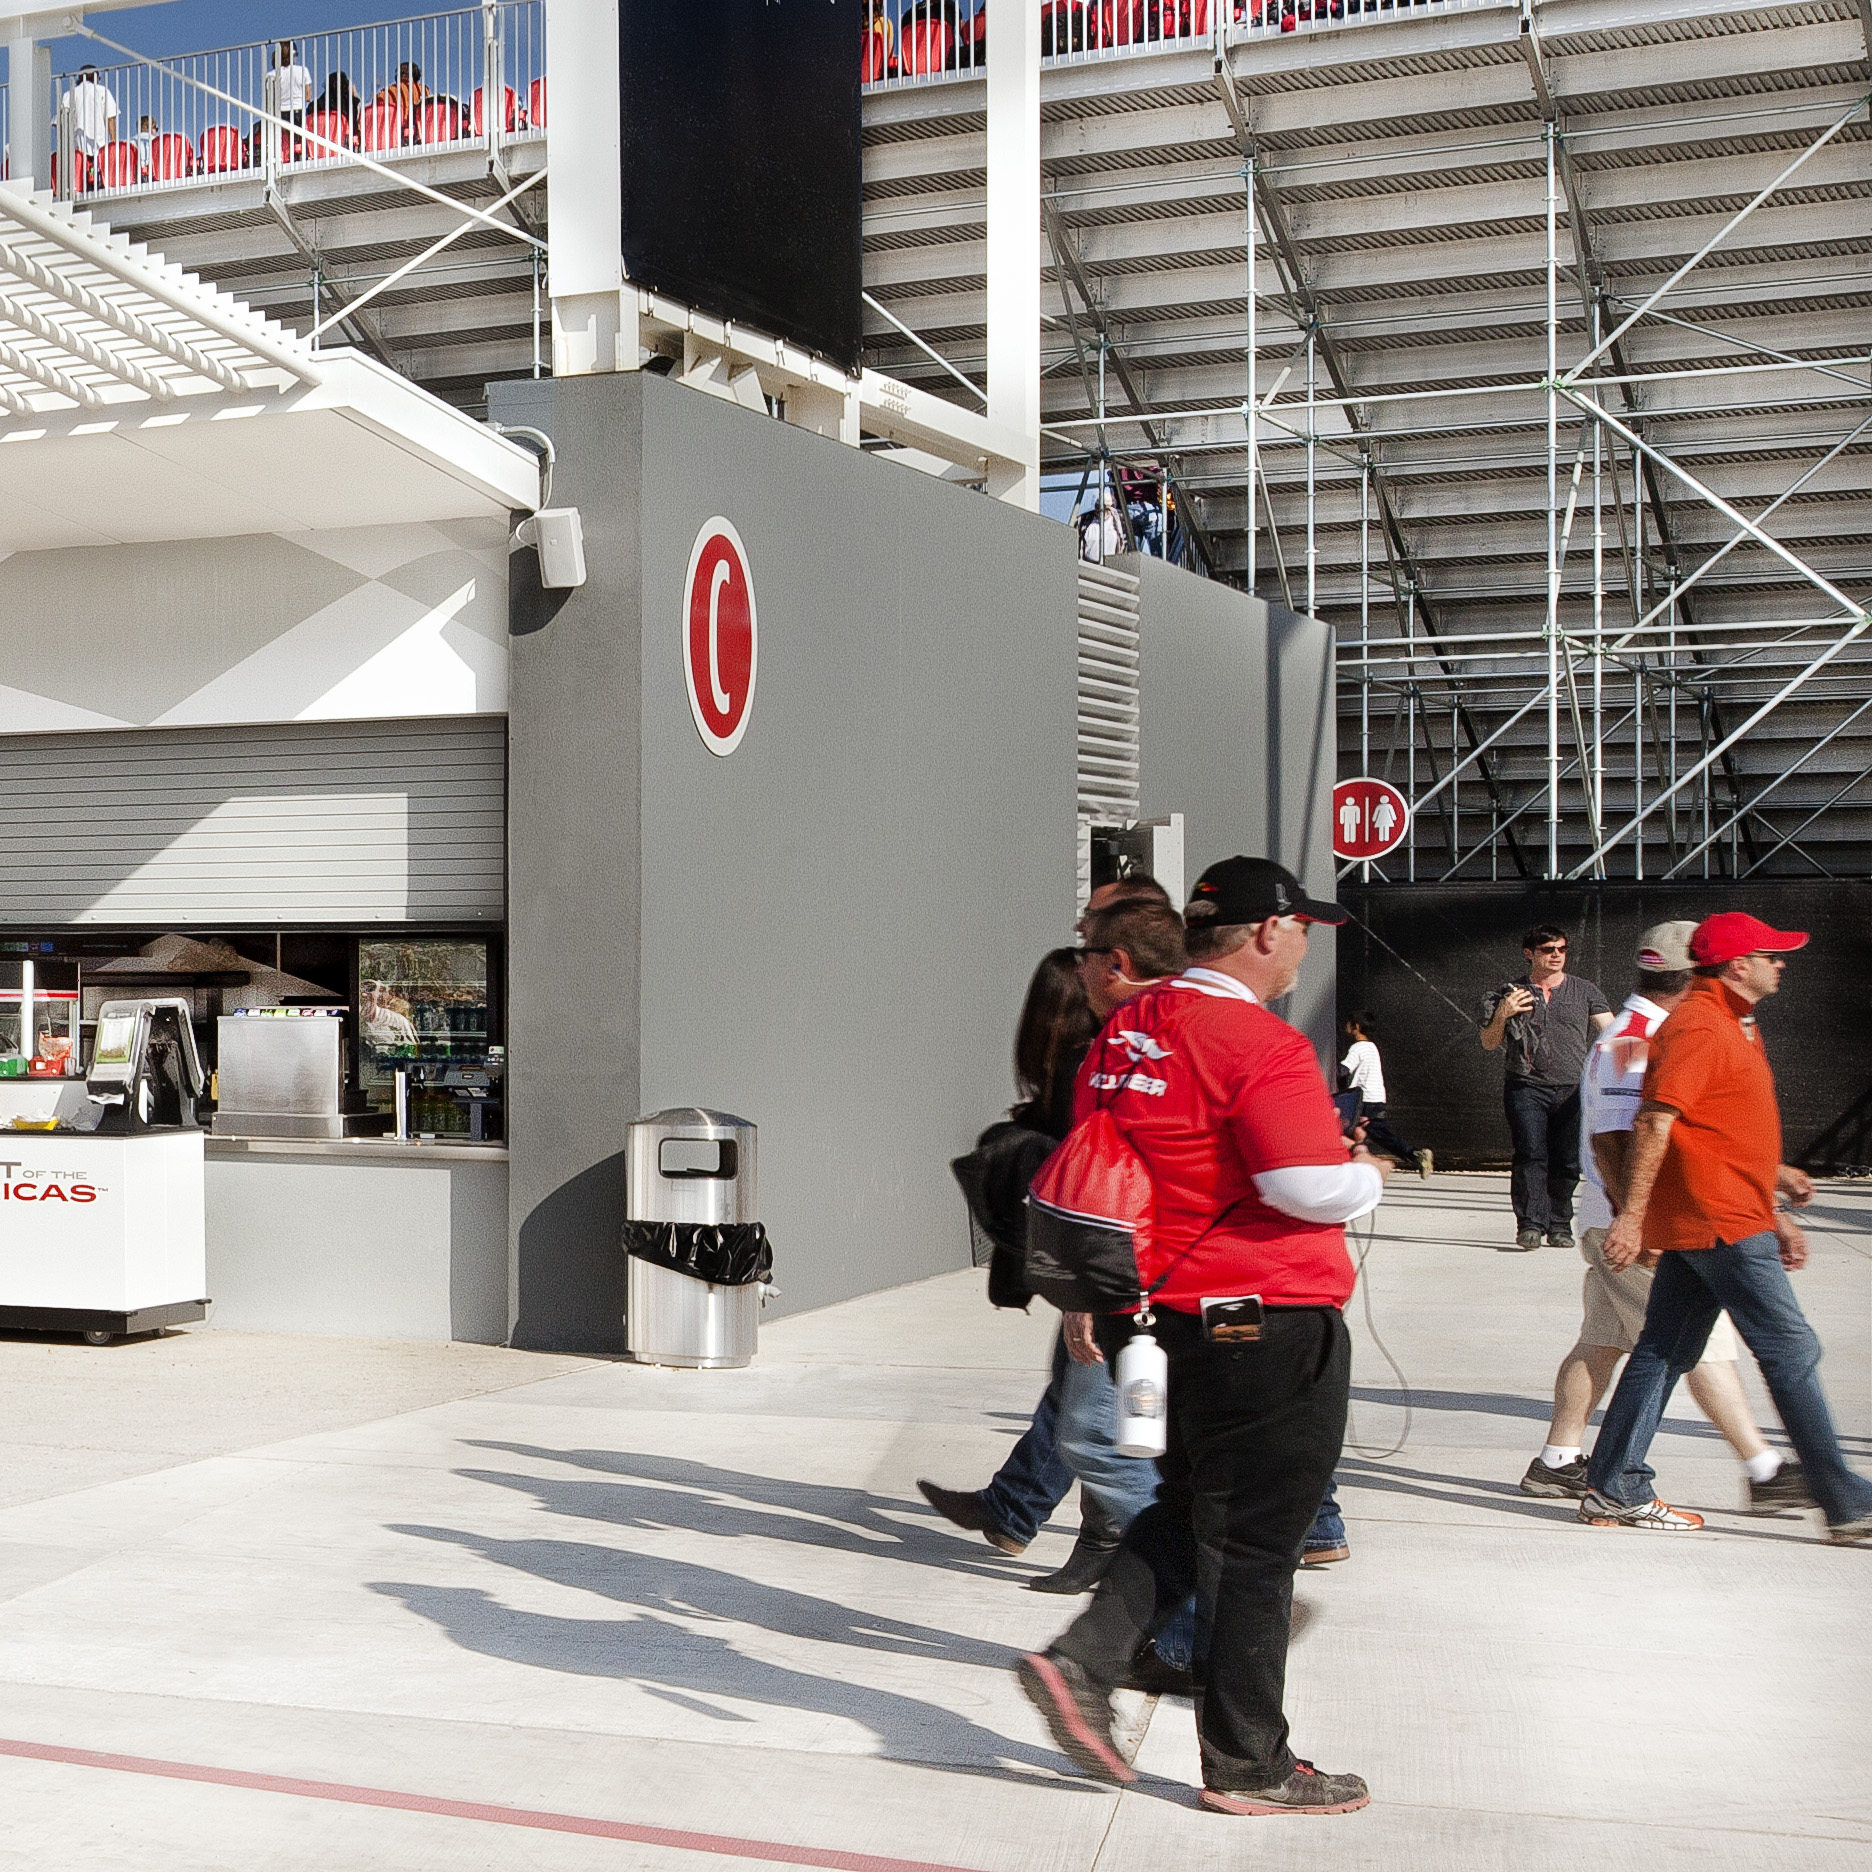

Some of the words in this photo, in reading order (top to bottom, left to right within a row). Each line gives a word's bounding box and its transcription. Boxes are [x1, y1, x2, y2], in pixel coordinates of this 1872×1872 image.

[709, 559, 731, 715] C
[22, 1170, 48, 1179] OF
[50, 1171, 87, 1180] THE
